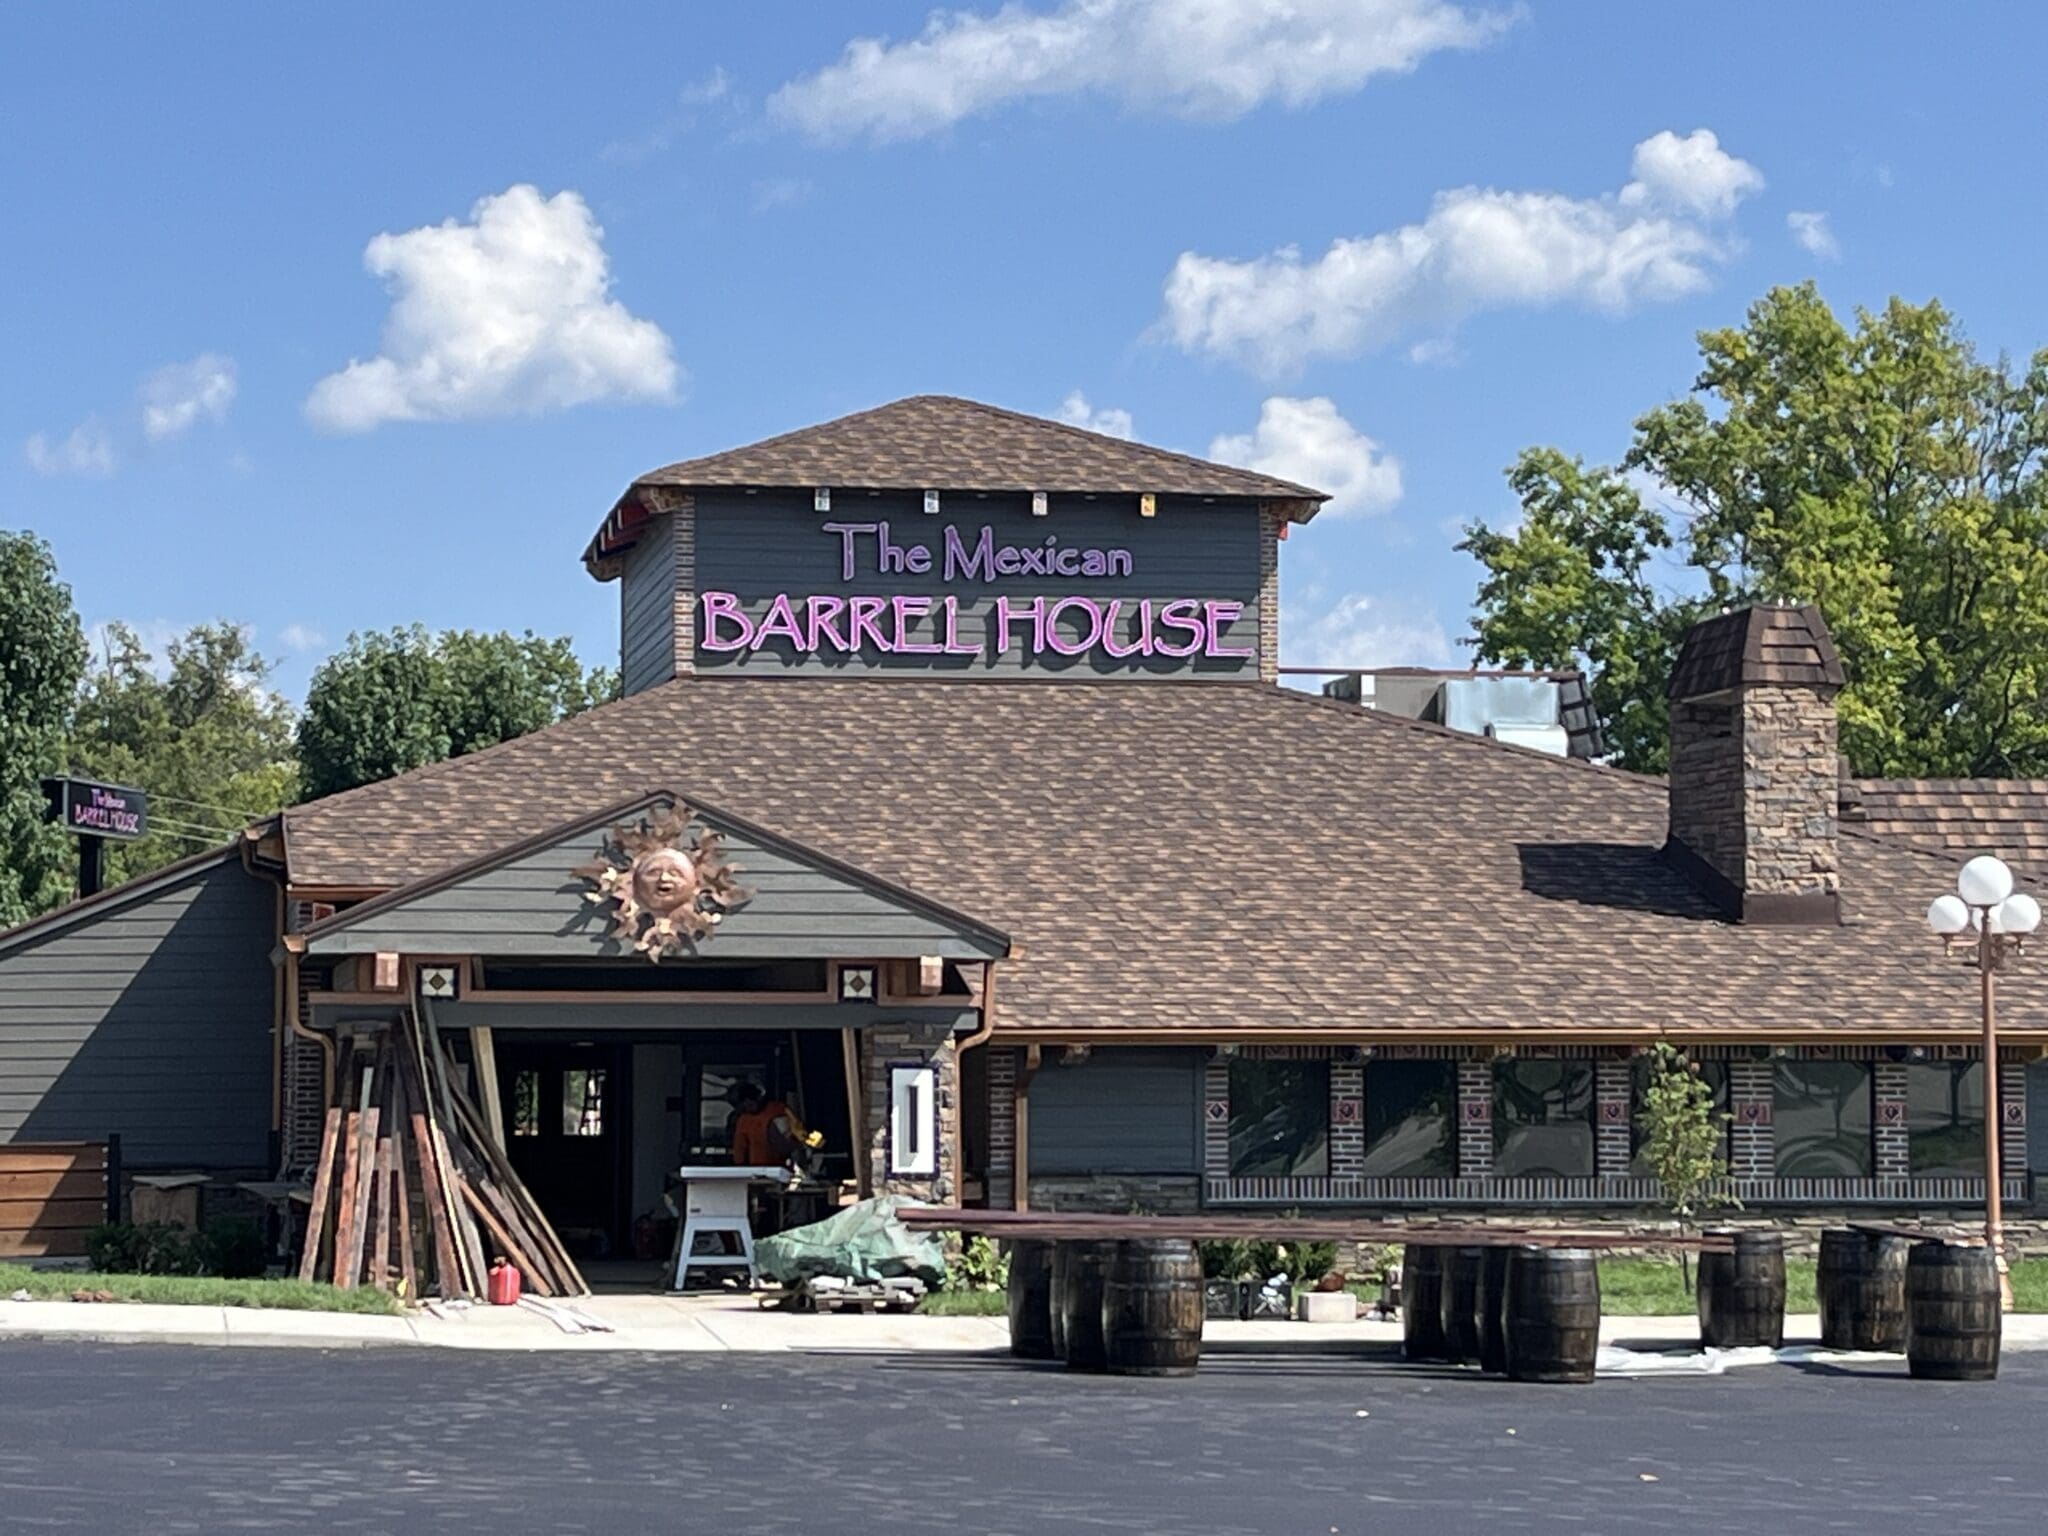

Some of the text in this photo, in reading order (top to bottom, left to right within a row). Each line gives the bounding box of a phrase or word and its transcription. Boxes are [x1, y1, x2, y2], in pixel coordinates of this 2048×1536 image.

[822, 521, 1133, 582] The Mexican
[701, 591, 1256, 658] BARREL HOUSE
